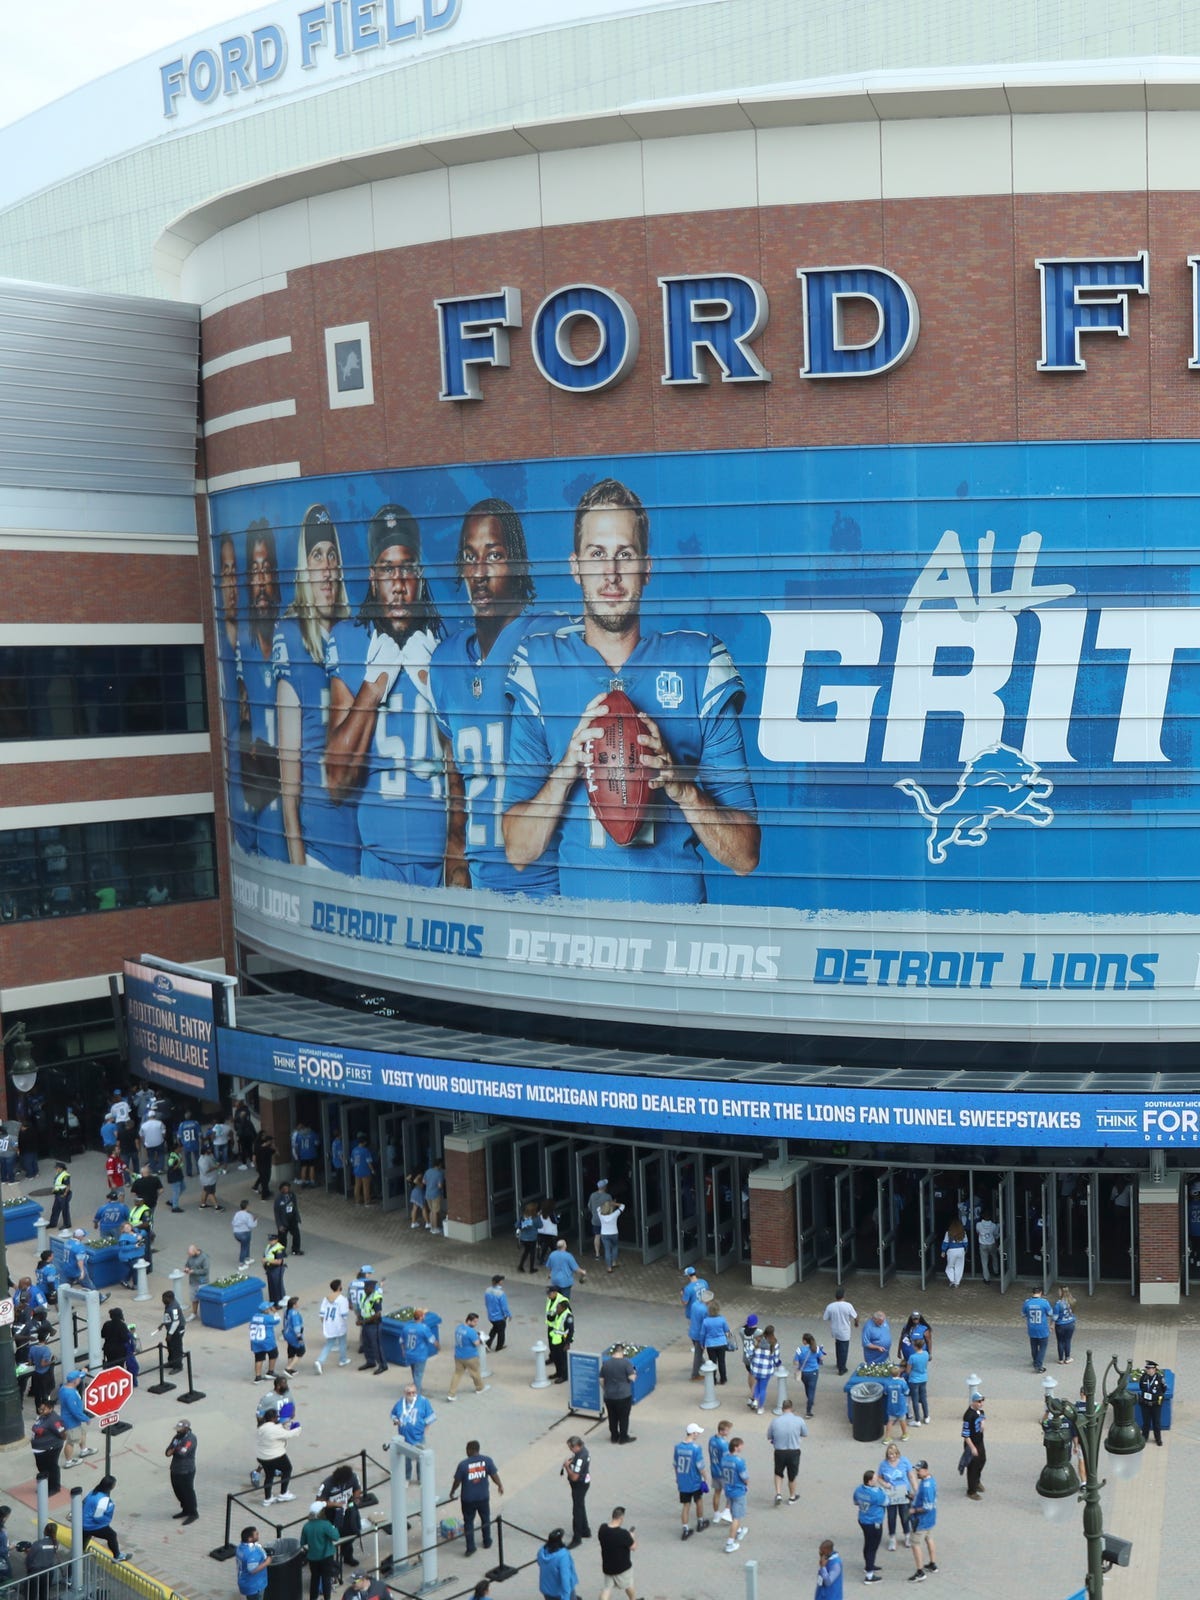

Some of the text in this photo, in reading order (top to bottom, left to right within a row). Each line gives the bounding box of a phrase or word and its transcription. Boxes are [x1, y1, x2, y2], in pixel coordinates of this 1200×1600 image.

[159, 0, 463, 118] FORD FIELD
[434, 264, 921, 402] FORD
[901, 529, 1077, 622] ALL
[457, 722, 508, 847] 21
[261, 885, 300, 923] LIONS
[311, 901, 485, 958] DETROIT LIONS
[506, 928, 782, 983] DETROIT LIONS
[813, 948, 1160, 991] DETROIT LIONS
[128, 999, 213, 1043] ADDITIONAL ENTRY
[159, 1036, 210, 1070] AVAILABLE
[273, 1055, 372, 1081] THINK FORD FIRST
[300, 1077, 346, 1090] DEALERS
[381, 1069, 1081, 1129] VISIT YOUR SOUTHEAST MICHIGAN FORD DEALER TO ENTER THE LIONS FAN TUNNEL SWEEPSTAKES
[183, 1131, 196, 1142] 81
[1097, 1114, 1138, 1127] THINK
[325, 1307, 337, 1321] 14
[1029, 1310, 1042, 1324] 58
[250, 1324, 266, 1341] 20
[406, 1334, 417, 1350] 16
[88, 1377, 130, 1407] STOP
[891, 1390, 898, 1404] 9
[677, 1456, 691, 1473] 97
